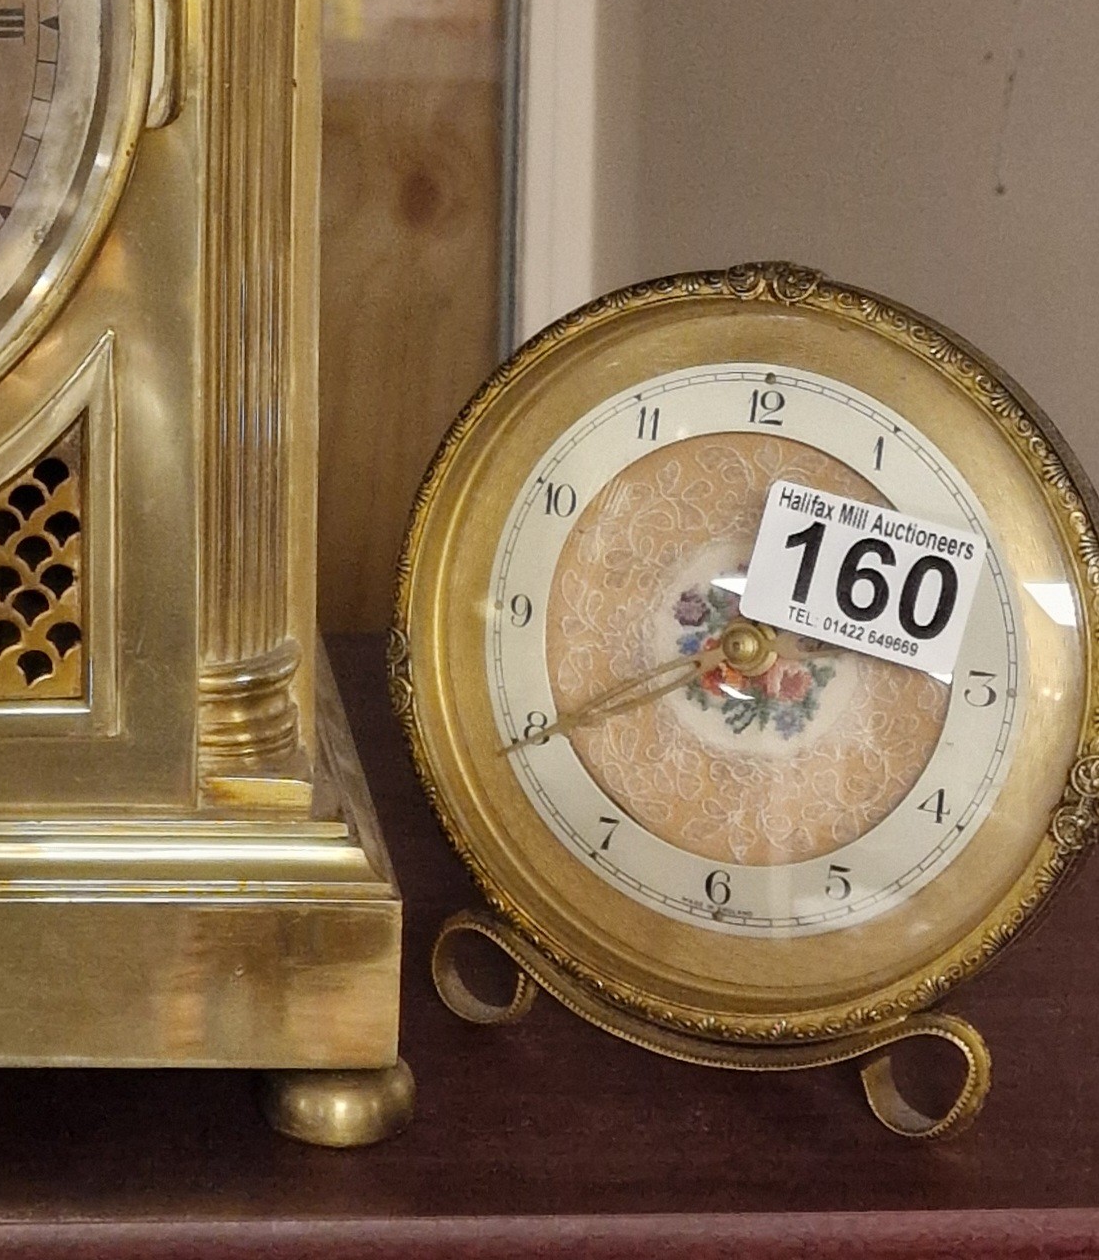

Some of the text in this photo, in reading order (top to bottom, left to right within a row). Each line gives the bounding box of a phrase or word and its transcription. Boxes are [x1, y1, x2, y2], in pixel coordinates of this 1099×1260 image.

[636, 406, 660, 441] 11
[748, 389, 786, 427] 12
[873, 436, 885, 471] 1
[544, 482, 577, 518] 10
[779, 486, 975, 561] Halifax Mill Auctioneers
[784, 520, 959, 640] 160
[510, 593, 533, 628] 9
[823, 617, 865, 641] 01422
[867, 630, 919, 656] 649669
[964, 670, 997, 707] 3
[523, 711, 550, 746] 8
[917, 788, 951, 824] 4
[599, 816, 621, 850] 7
[705, 869, 731, 905] 6
[824, 865, 853, 900] 5
